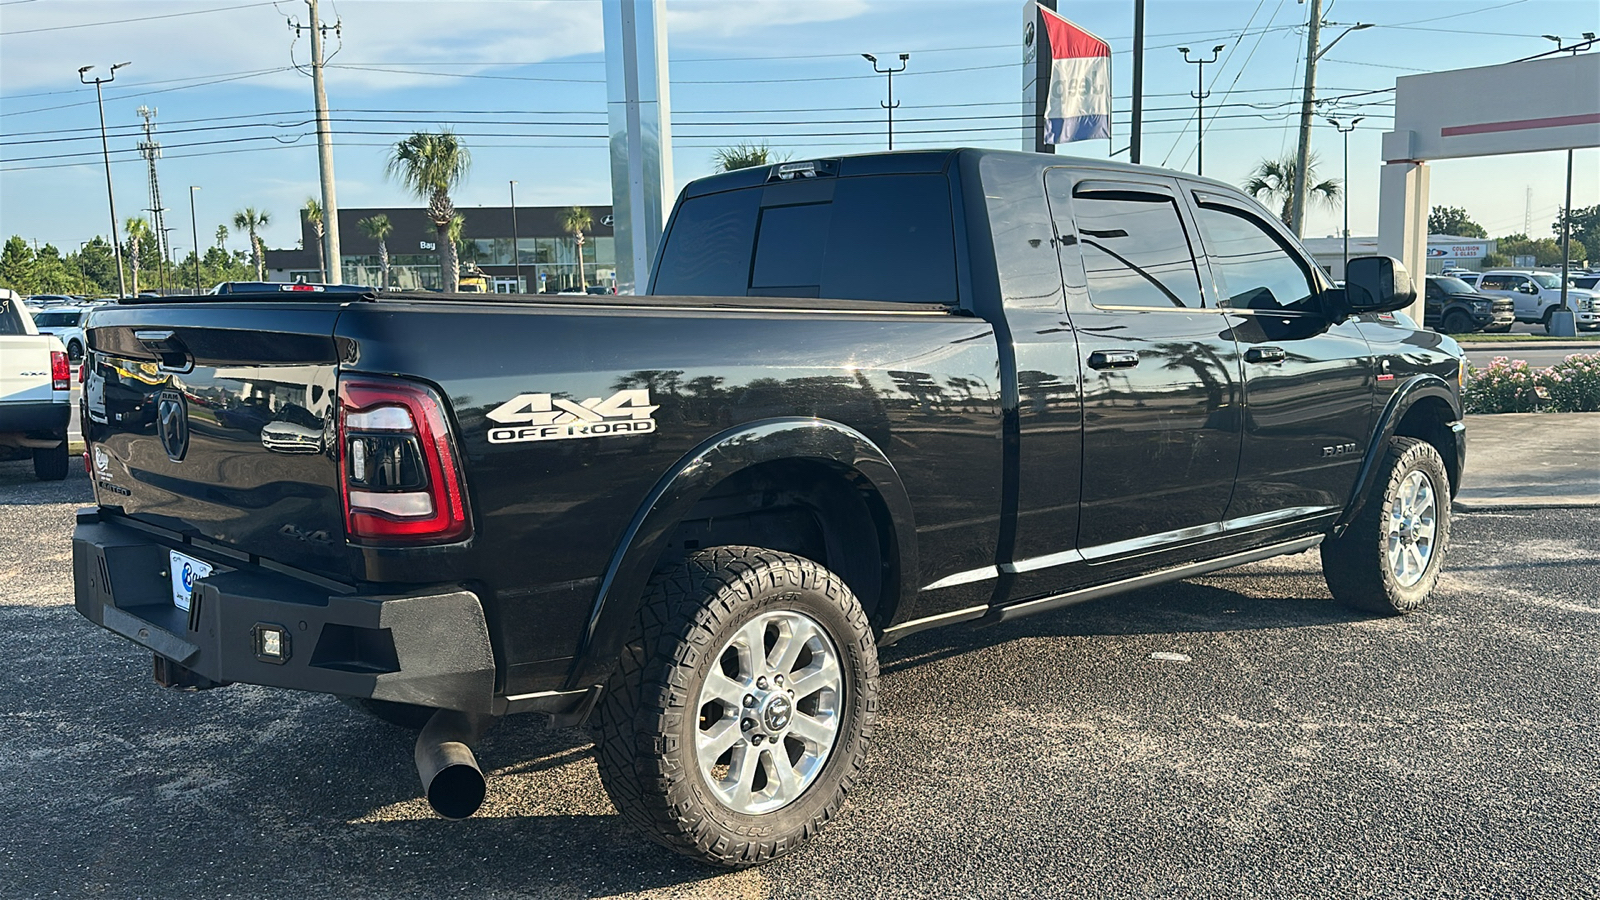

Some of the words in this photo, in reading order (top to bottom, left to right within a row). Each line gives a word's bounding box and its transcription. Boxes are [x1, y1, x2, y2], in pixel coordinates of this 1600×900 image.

[420, 241, 436, 251] Bay
[162, 392, 179, 400] RAM
[492, 427, 560, 441] OFF
[567, 421, 653, 436] ROAD
[1322, 443, 1357, 457] RAM
